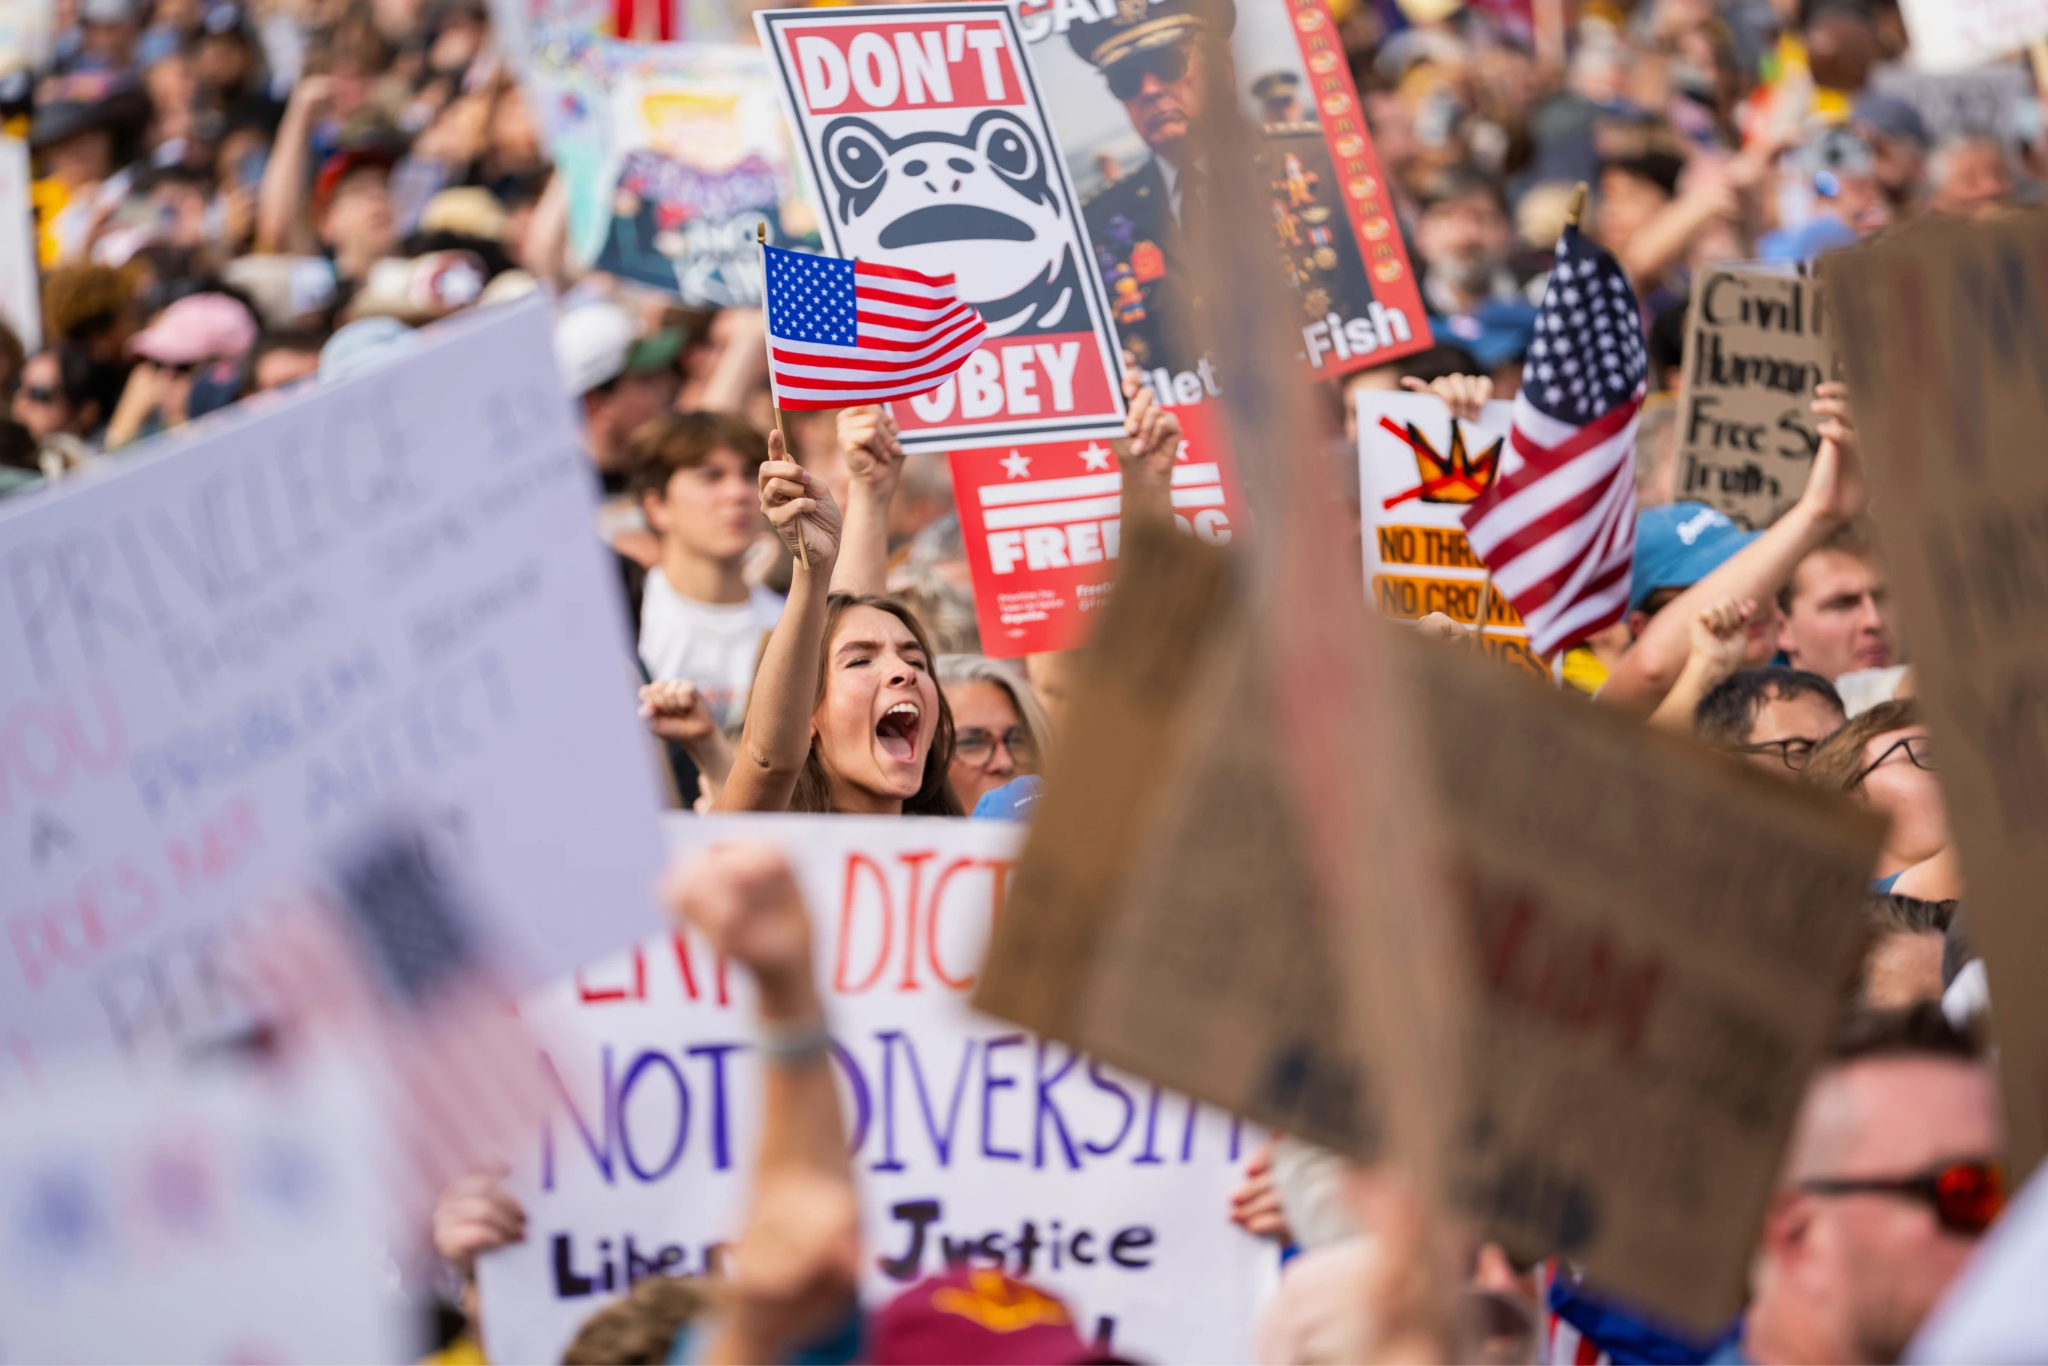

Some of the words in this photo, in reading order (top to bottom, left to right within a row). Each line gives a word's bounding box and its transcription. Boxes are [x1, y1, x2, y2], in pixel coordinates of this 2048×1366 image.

[796, 24, 1006, 109] DON'T
[1704, 272, 1803, 333] Civil
[1687, 396, 1767, 452] Free
[1381, 528, 1417, 563] NO
[1423, 530, 1483, 567] THR
[1381, 578, 1419, 614] NO
[834, 851, 1013, 994] DICT
[539, 1044, 752, 1191] NOT
[879, 1200, 1155, 1281] Justice
